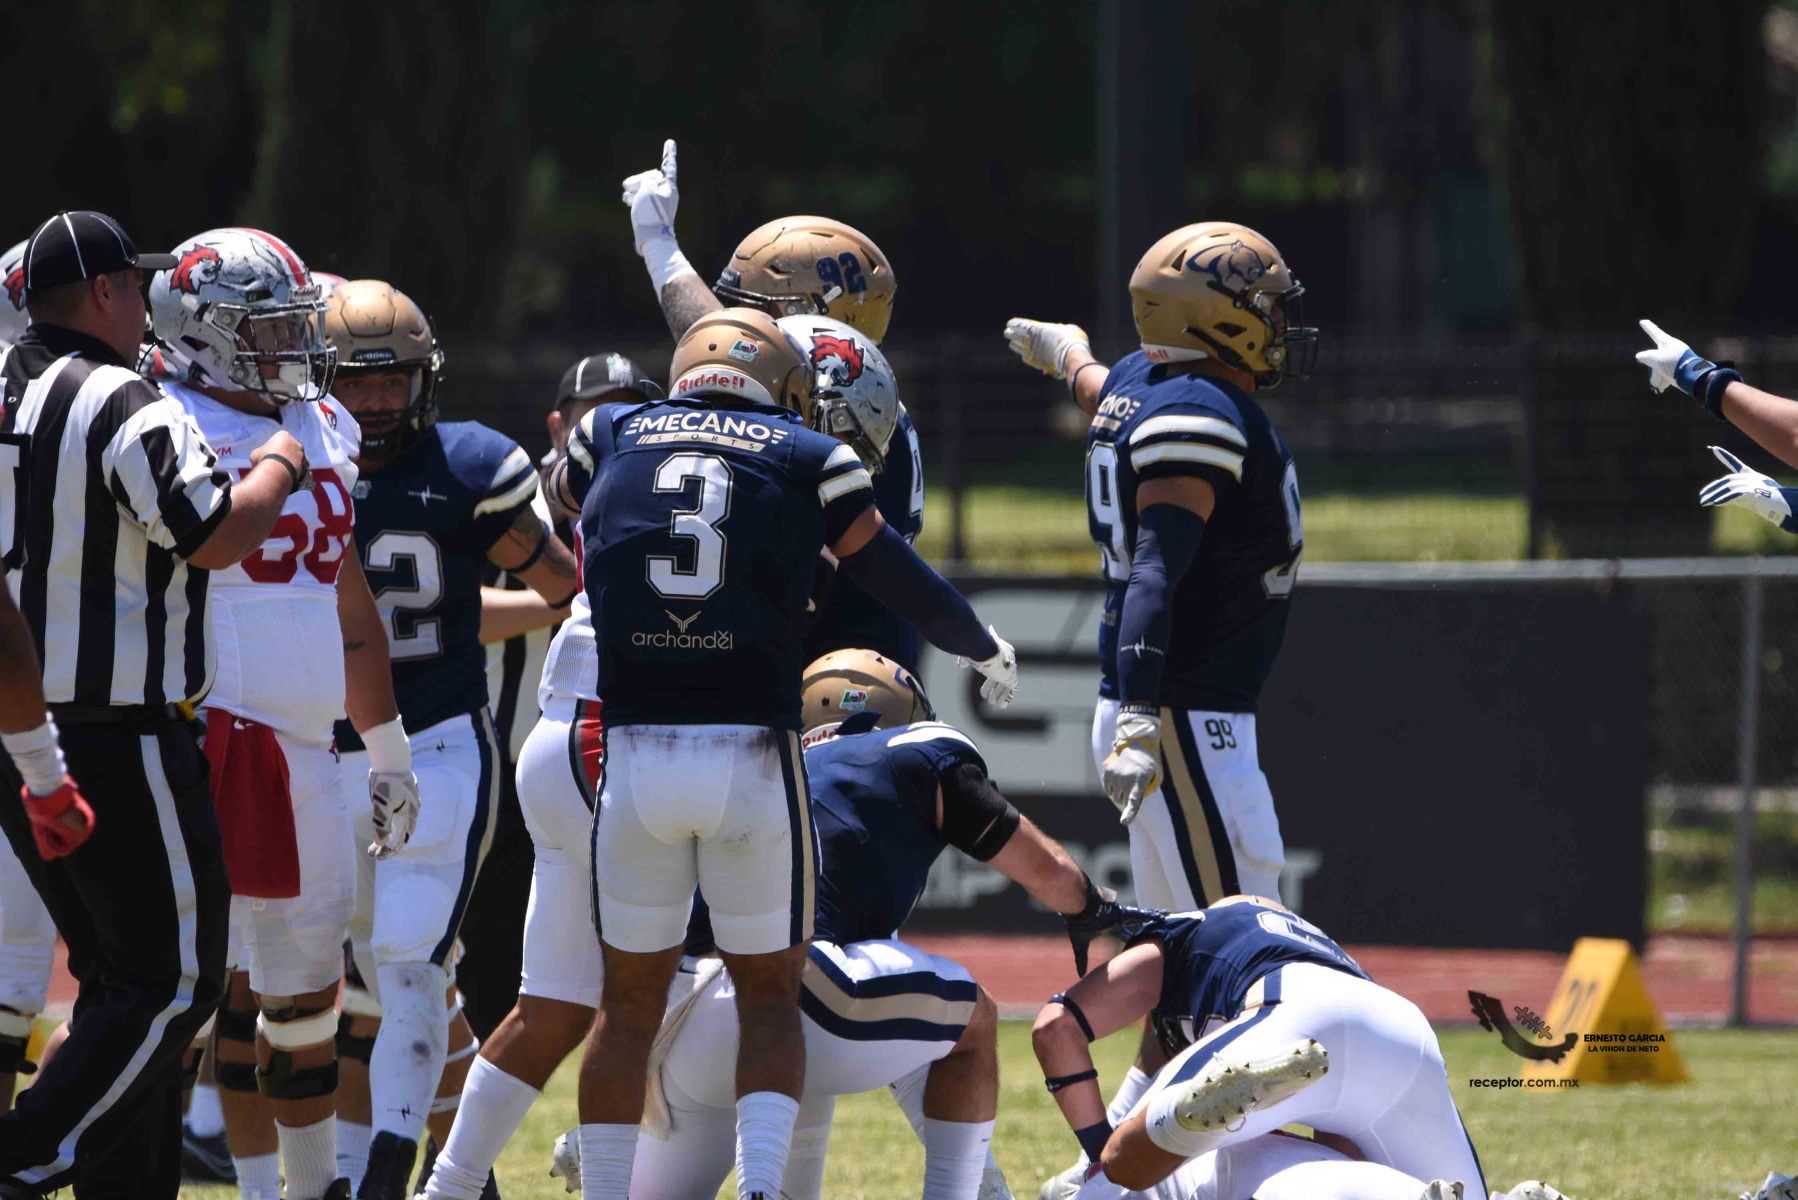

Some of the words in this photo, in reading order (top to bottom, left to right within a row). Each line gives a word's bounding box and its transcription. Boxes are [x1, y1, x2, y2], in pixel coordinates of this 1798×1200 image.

[816, 251, 867, 295] 92
[678, 373, 745, 394] Riddell
[638, 412, 771, 440] MECANO
[655, 433, 758, 451] SPORTS
[646, 452, 734, 600] 3
[1204, 718, 1237, 750] 99
